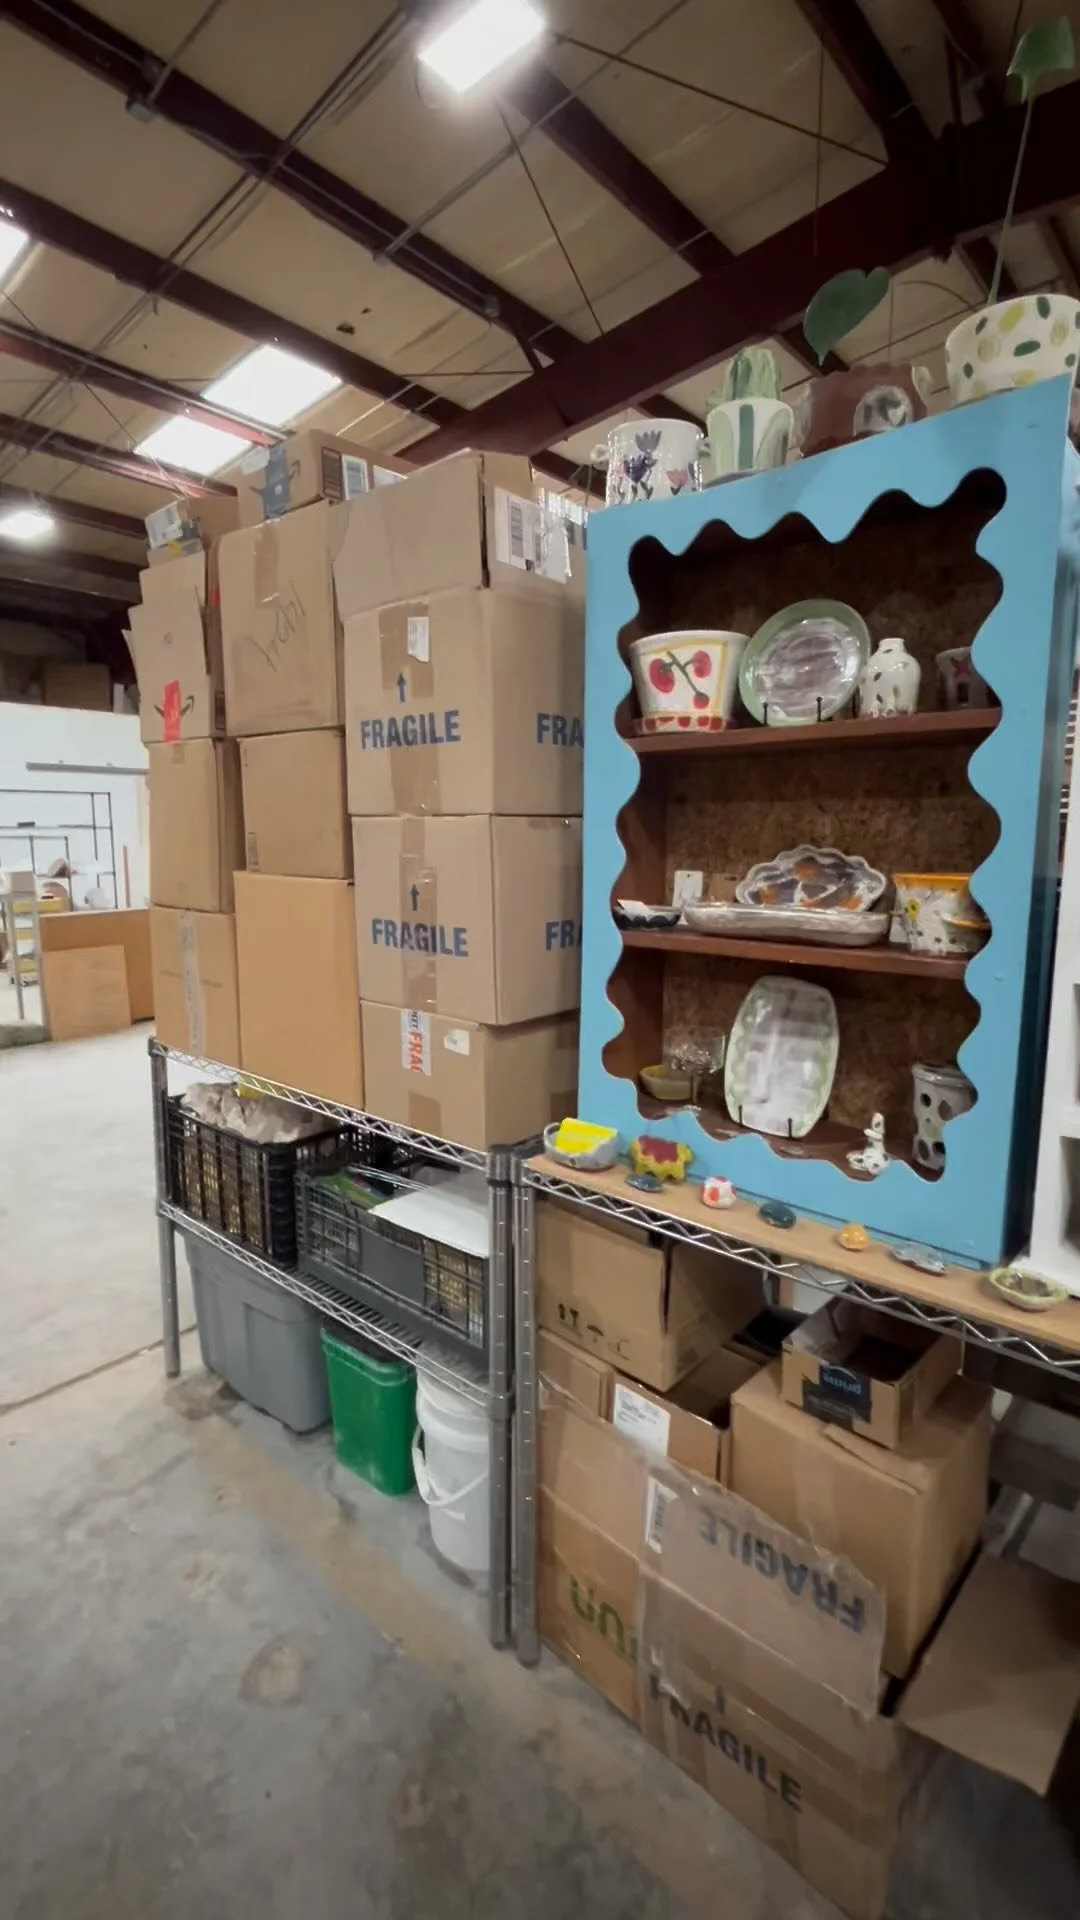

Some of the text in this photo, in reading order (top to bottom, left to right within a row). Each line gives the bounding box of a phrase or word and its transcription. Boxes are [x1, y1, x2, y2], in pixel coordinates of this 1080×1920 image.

[360, 709, 461, 749] FRAGILE
[371, 917, 469, 957] FRAGILE
[545, 919, 583, 952] FR
[700, 1507, 866, 1635] FRAGILE
